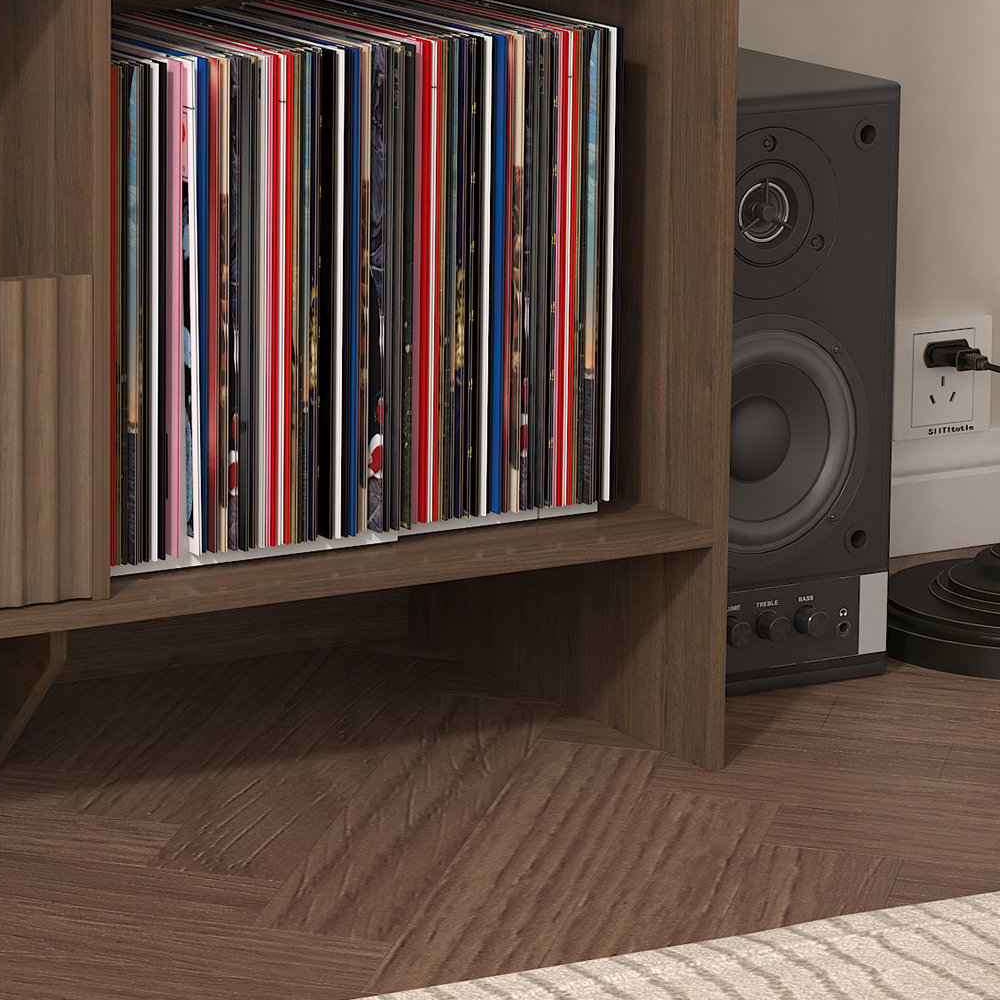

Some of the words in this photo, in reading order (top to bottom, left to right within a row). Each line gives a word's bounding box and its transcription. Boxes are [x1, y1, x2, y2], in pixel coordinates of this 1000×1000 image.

[797, 594, 814, 603] BASS
[726, 604, 741, 612] UME
[755, 599, 779, 609] TREBLE
